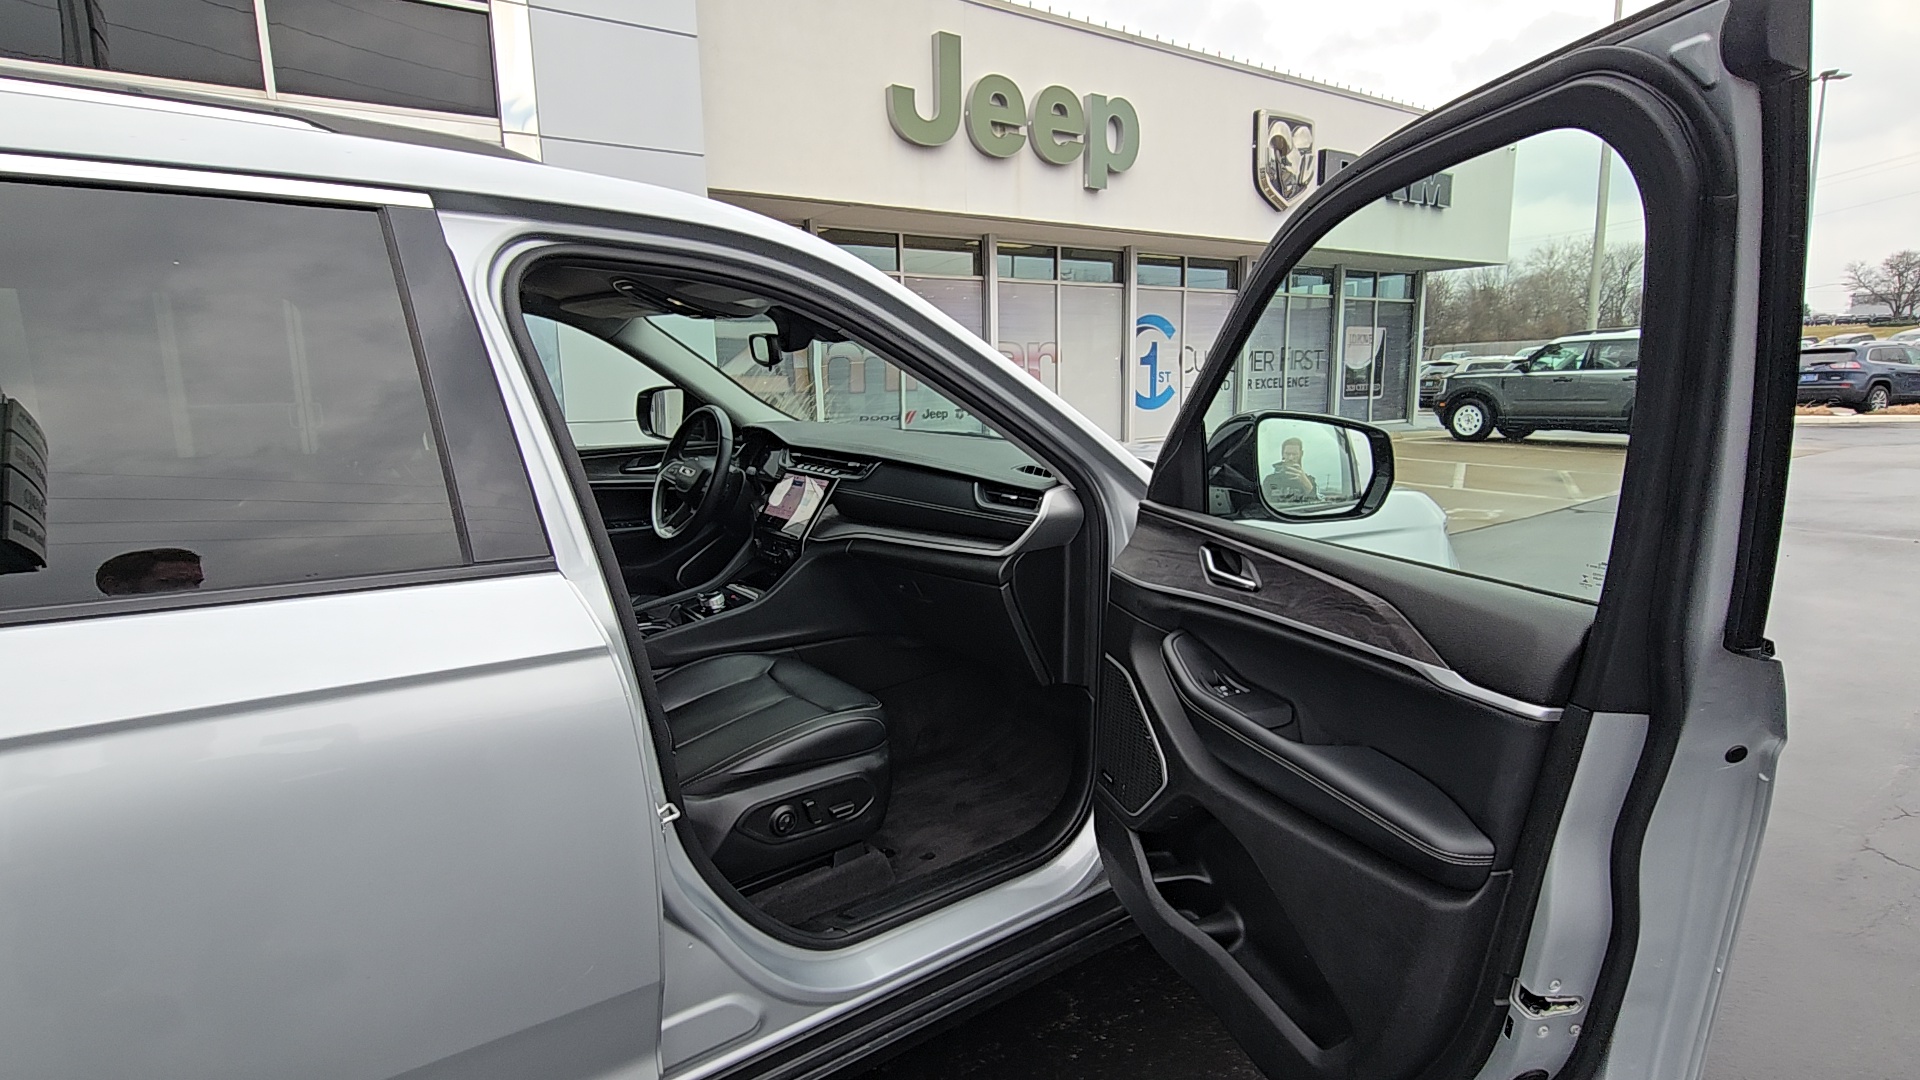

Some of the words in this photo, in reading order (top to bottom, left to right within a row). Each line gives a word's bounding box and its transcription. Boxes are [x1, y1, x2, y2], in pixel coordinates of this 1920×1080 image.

[885, 31, 1140, 191] Jeep
[1317, 149, 1454, 208] RM
[1255, 376, 1310, 390] EXCELENCE
[859, 414, 900, 422] DODG
[922, 408, 948, 420] Jeep
